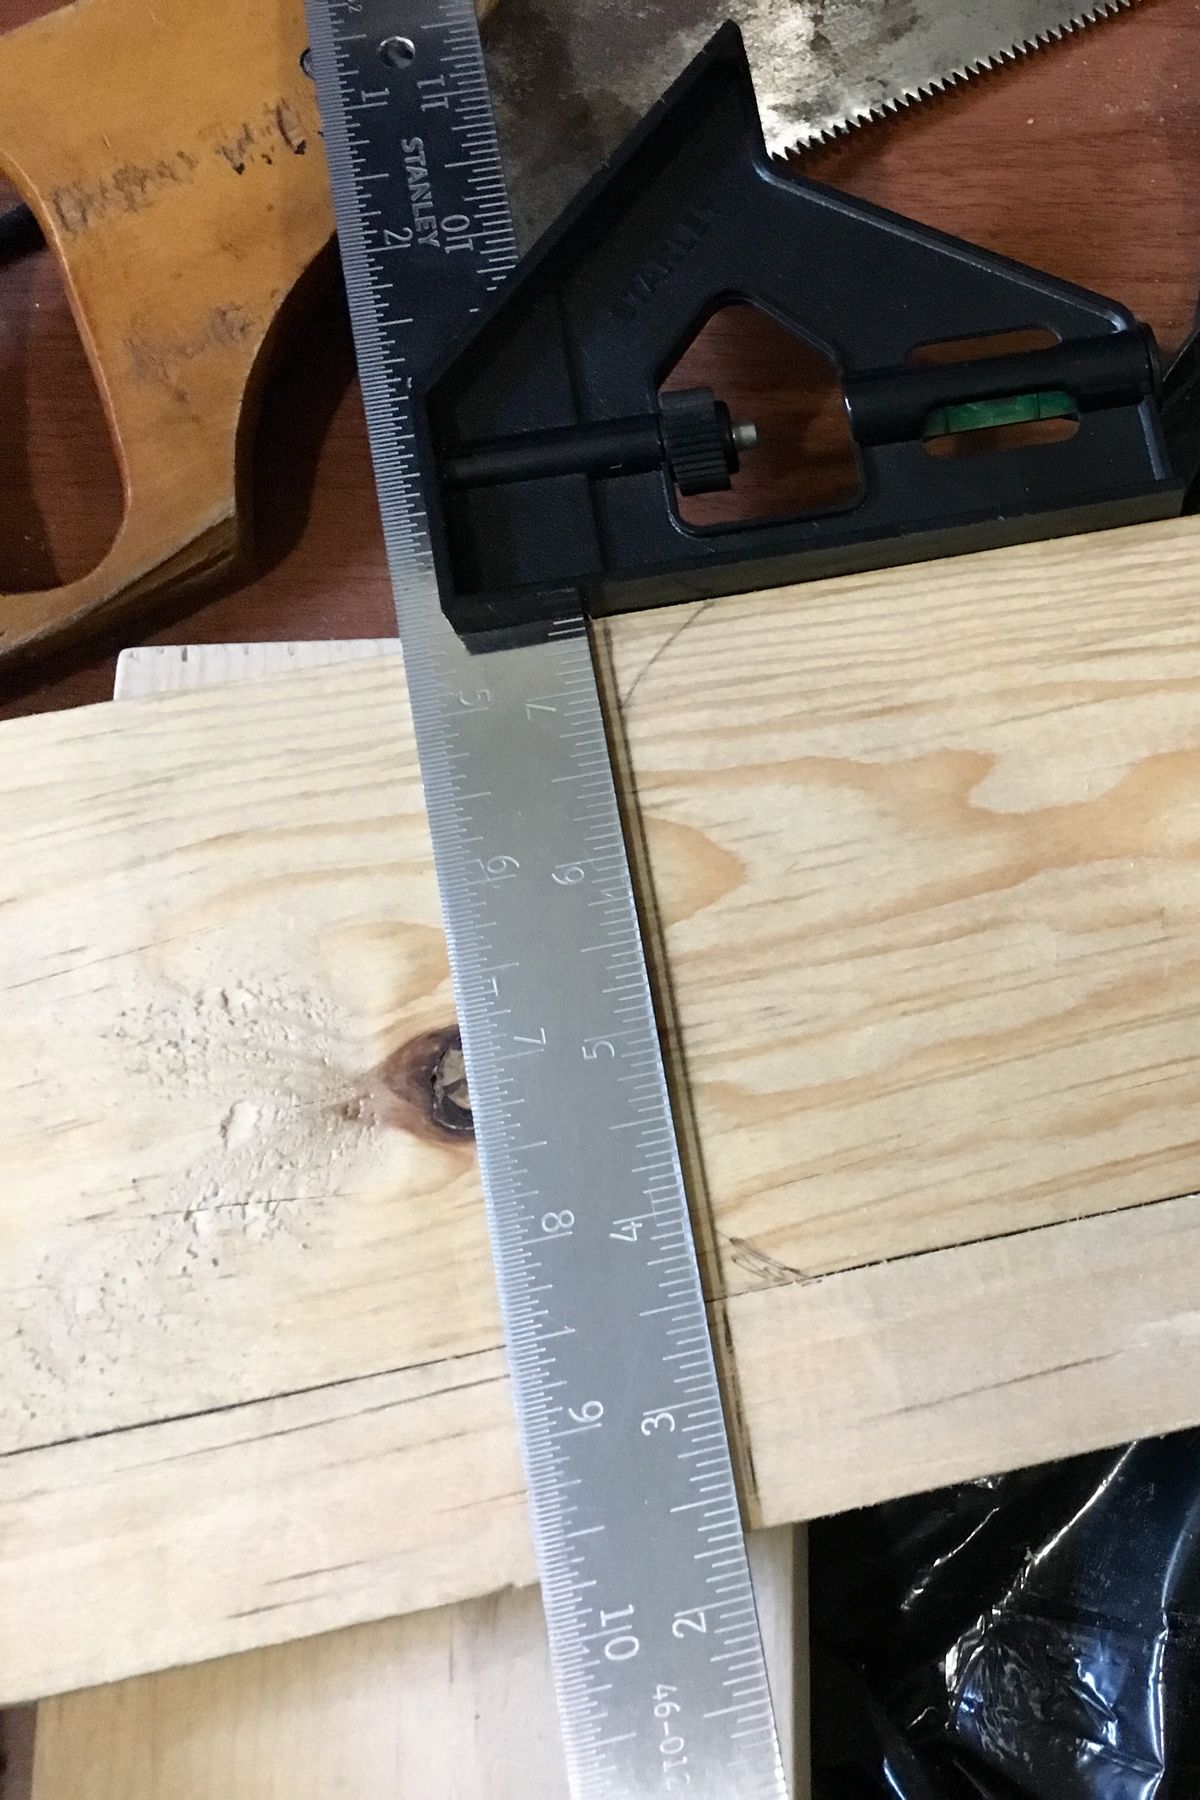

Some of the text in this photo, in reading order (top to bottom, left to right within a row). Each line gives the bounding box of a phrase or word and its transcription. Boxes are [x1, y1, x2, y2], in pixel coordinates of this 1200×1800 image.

[416, 74, 449, 112] 11
[401, 136, 441, 248] STANLEY
[383, 227, 413, 246] 2
[440, 214, 474, 254] 10
[487, 855, 520, 874] 6
[551, 865, 585, 886] 6
[513, 1027, 546, 1045] 7
[582, 1039, 615, 1060] 5
[541, 1209, 575, 1233] 8
[608, 1221, 643, 1242] 4
[568, 1400, 604, 1423] 9
[641, 1412, 675, 1436] 3
[601, 1604, 640, 1661] 10
[672, 1612, 706, 1638] 2
